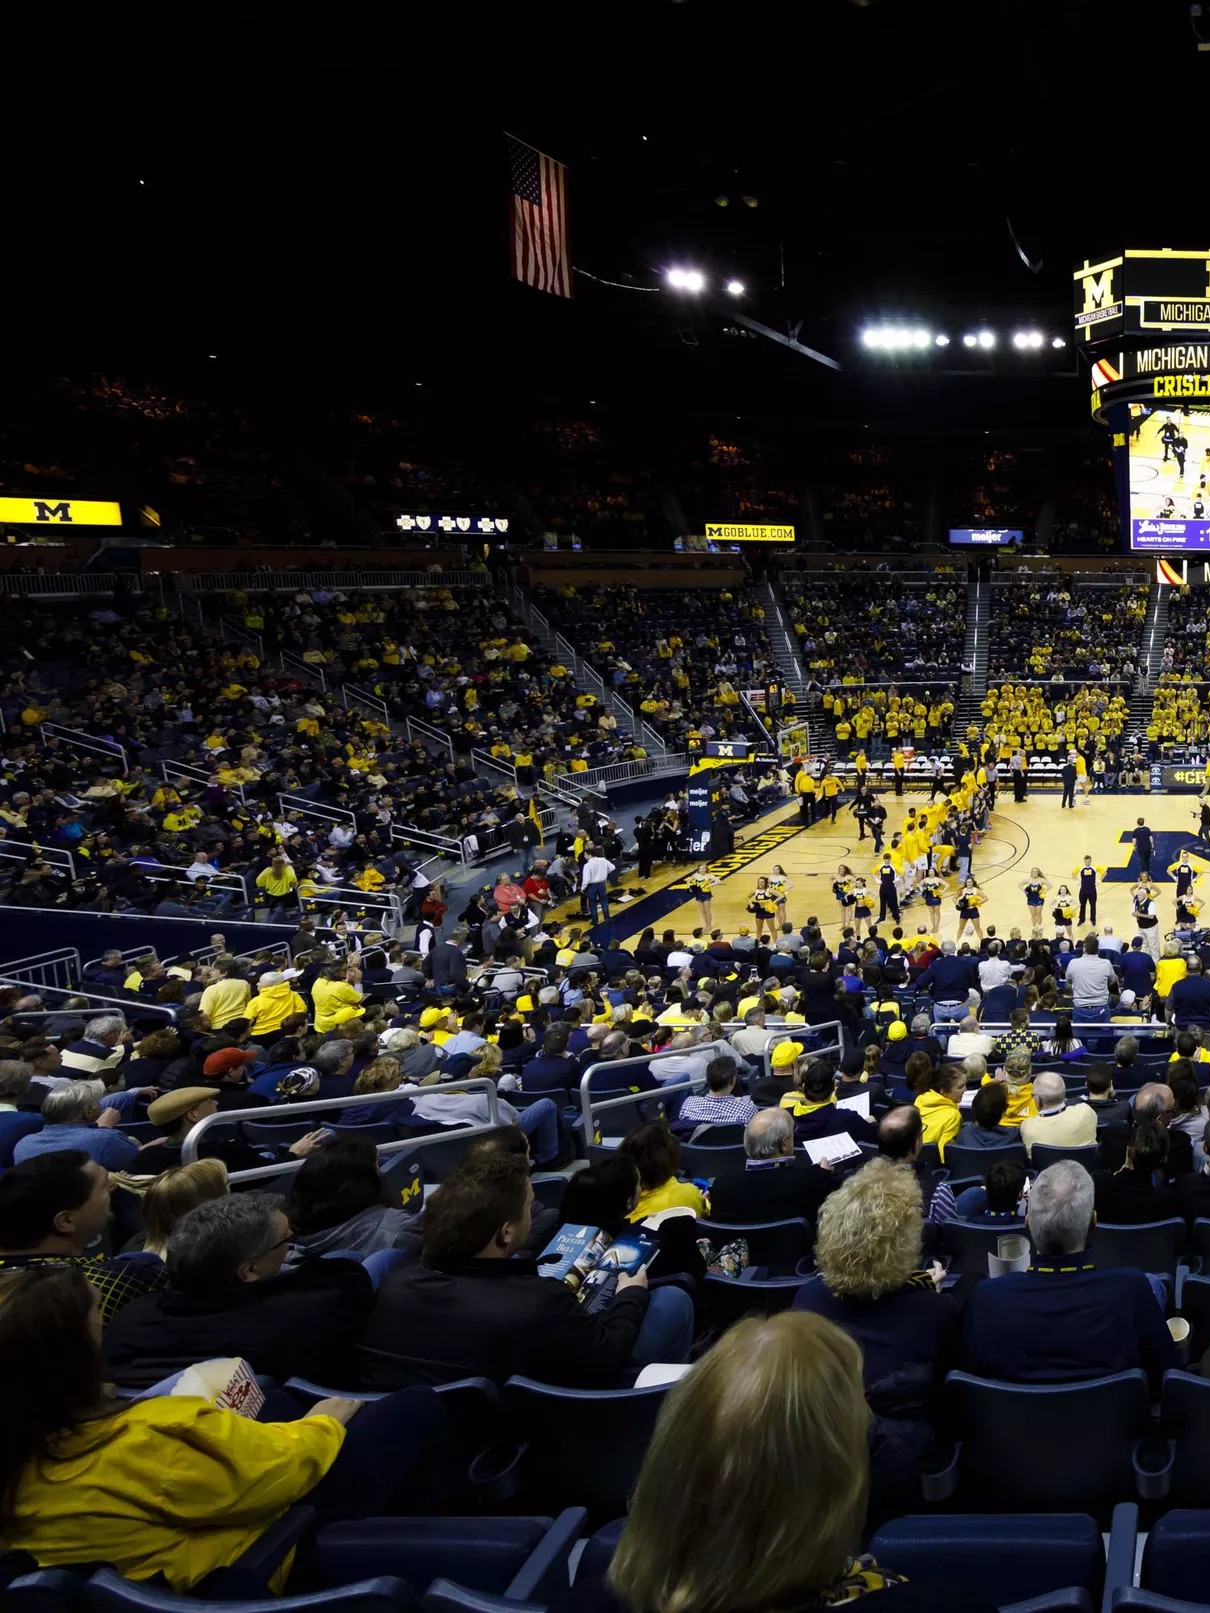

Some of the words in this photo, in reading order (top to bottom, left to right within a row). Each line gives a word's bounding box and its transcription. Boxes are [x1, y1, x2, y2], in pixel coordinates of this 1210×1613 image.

[1083, 269, 1113, 312] M
[1136, 346, 1208, 373] MICHIGAN
[35, 502, 72, 521] M
[971, 531, 1001, 543] meijer
[718, 745, 734, 756] M
[690, 788, 708, 796] meijer
[690, 800, 708, 808] meijer
[401, 1177, 421, 1206] M
[556, 1244, 574, 1253] BELL
